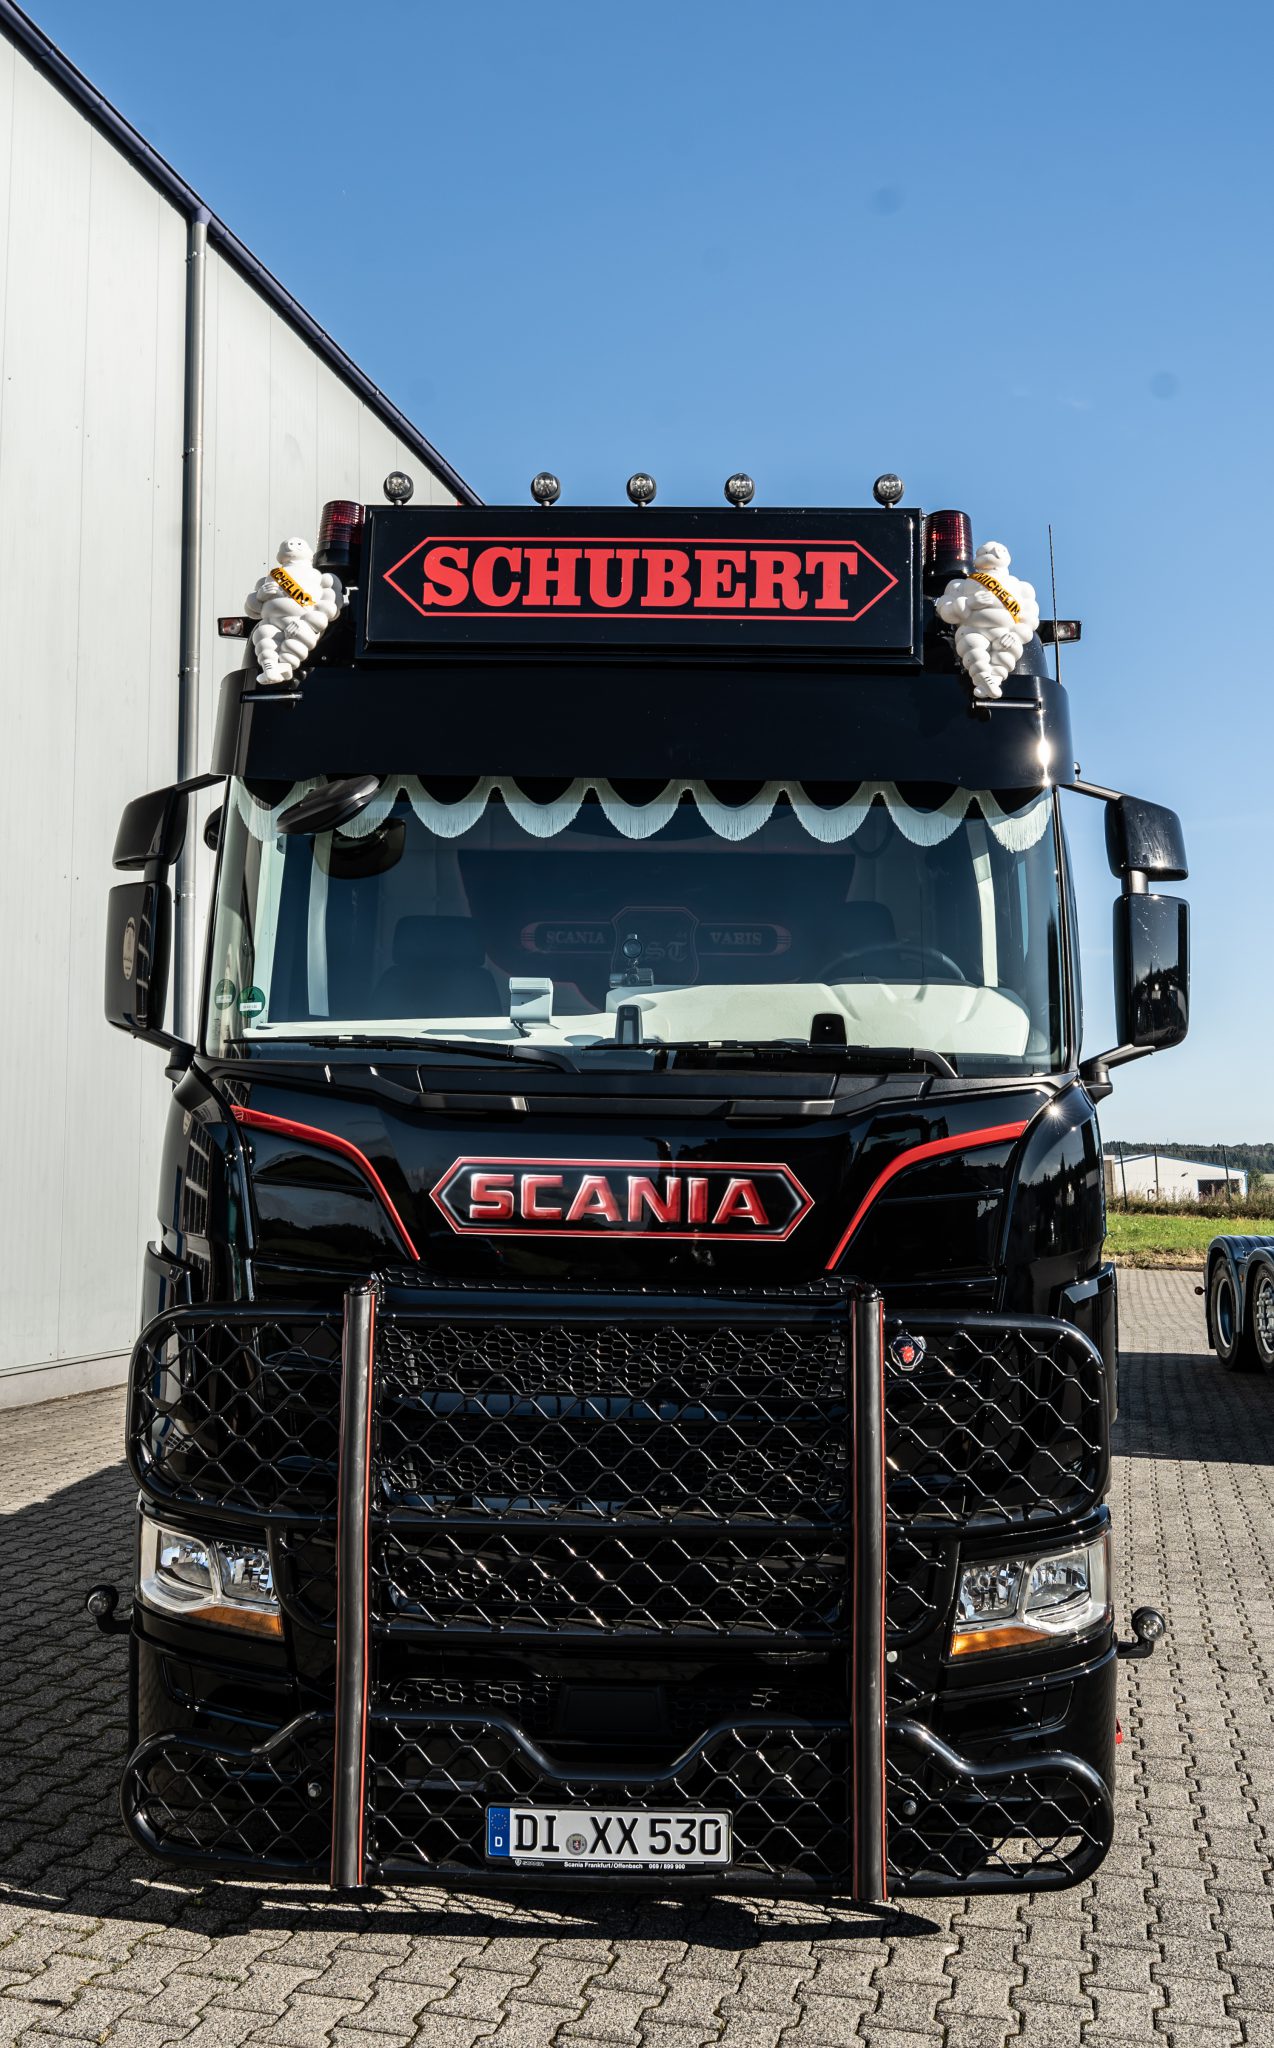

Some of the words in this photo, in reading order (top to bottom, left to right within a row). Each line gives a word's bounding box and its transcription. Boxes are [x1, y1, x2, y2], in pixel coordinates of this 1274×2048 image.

[423, 547, 858, 610] SCHUBERT
[975, 572, 1020, 616] MICHELIN
[546, 930, 605, 945] SCANIA
[709, 931, 763, 946] VABIS
[247, 988, 256, 1002] 4
[469, 1173, 769, 1225] SCANIA
[494, 1836, 503, 1847] D
[515, 1813, 560, 1852] DI
[589, 1816, 639, 1855] XX
[650, 1818, 721, 1855] 530
